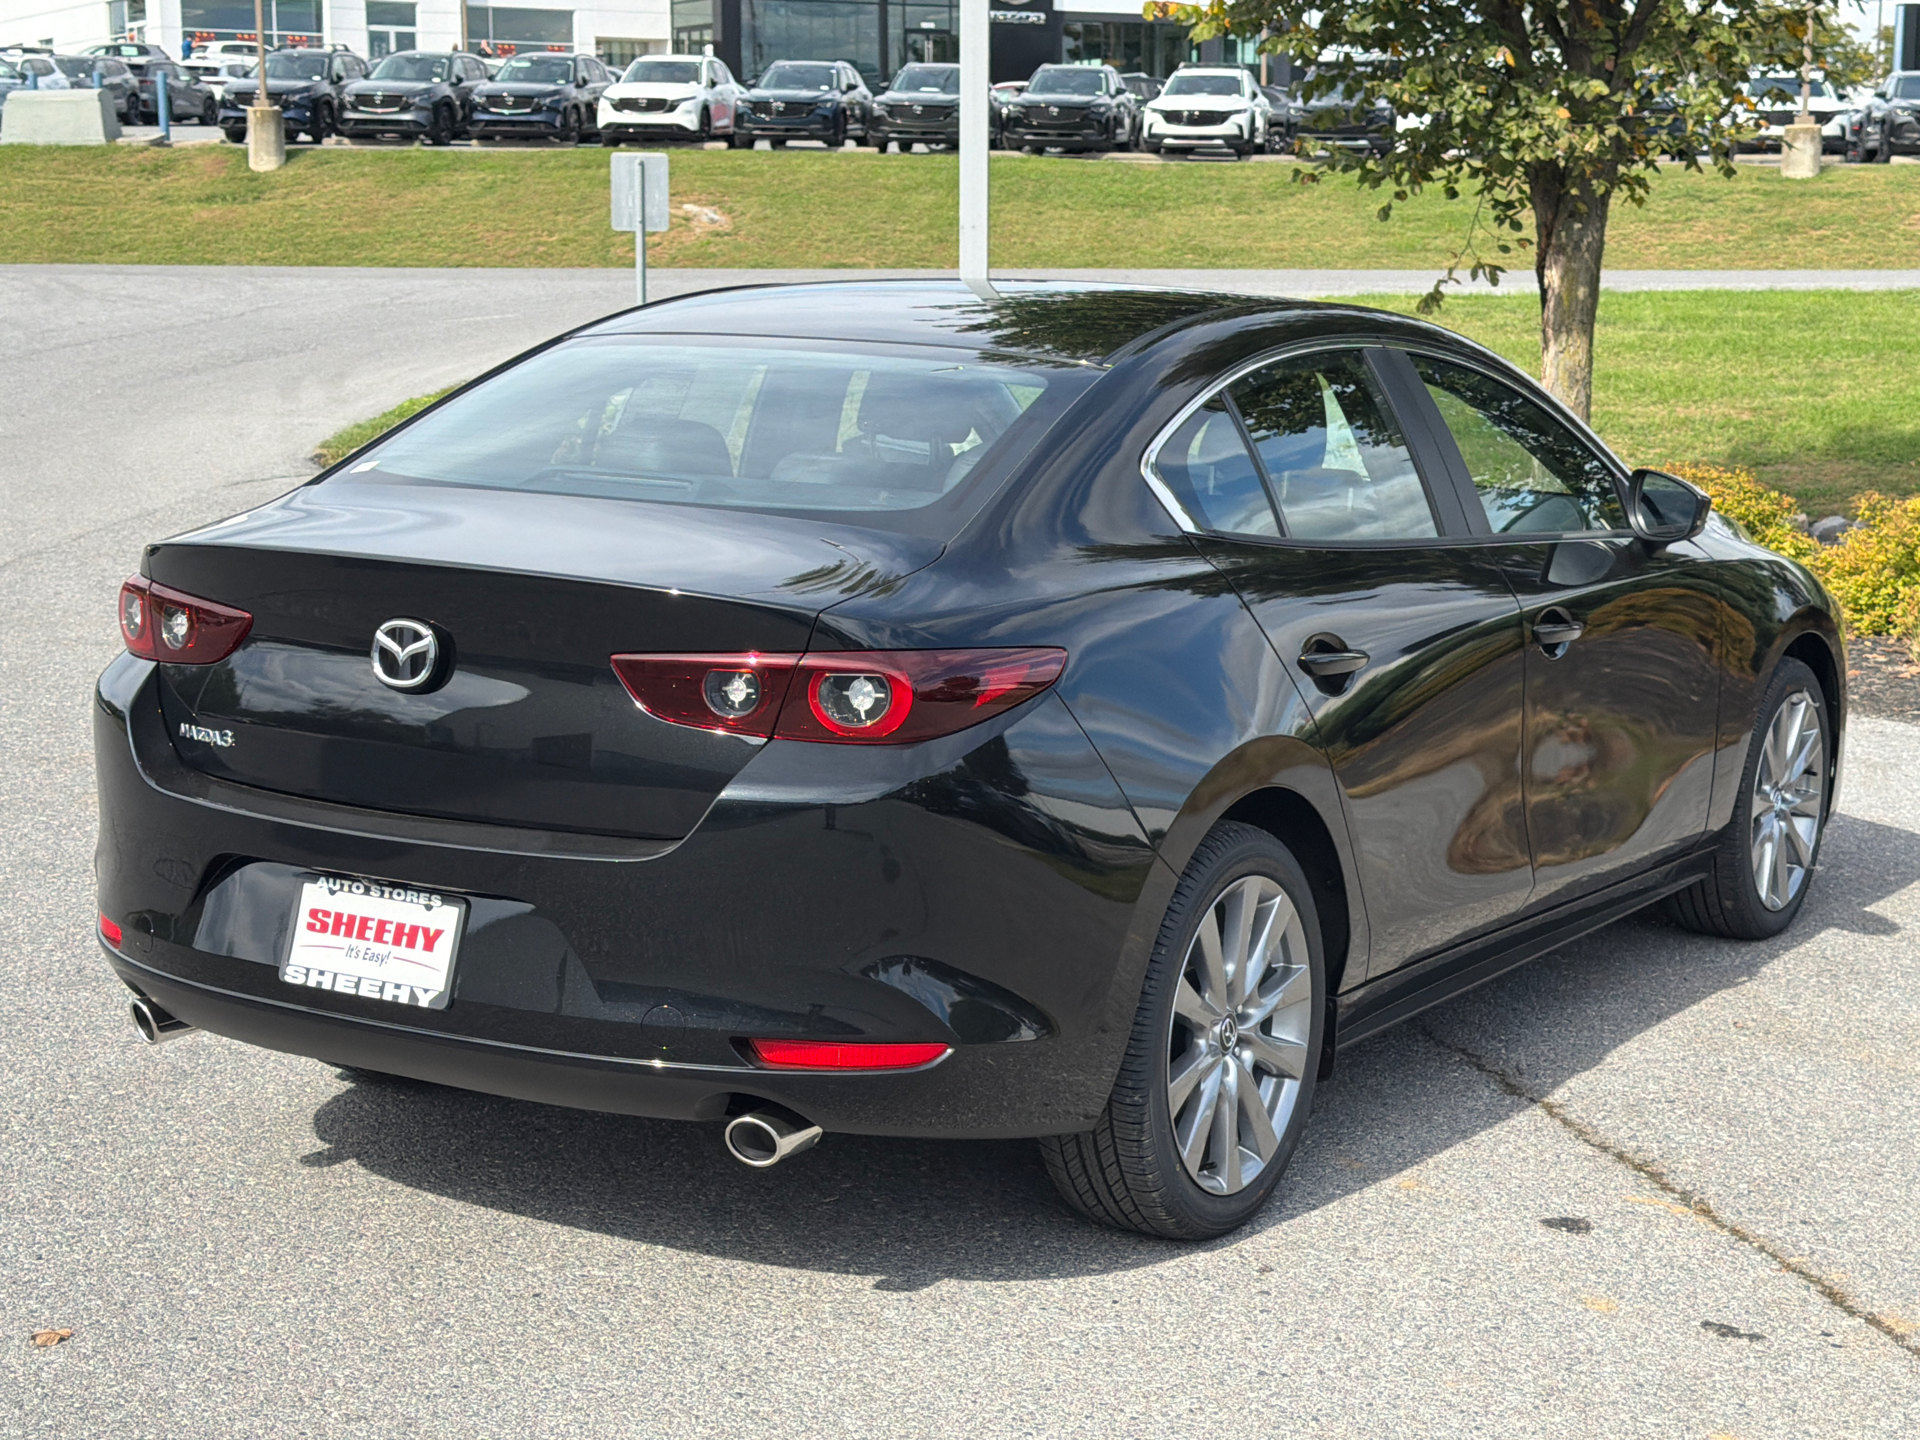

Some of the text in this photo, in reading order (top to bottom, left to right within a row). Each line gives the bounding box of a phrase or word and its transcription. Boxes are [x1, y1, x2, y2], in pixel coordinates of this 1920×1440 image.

[316, 876, 443, 907] AUTO STORES
[306, 907, 446, 953] SHEEHY
[345, 943, 391, 967] It's Easy!
[283, 965, 440, 1008] SHEEHY
